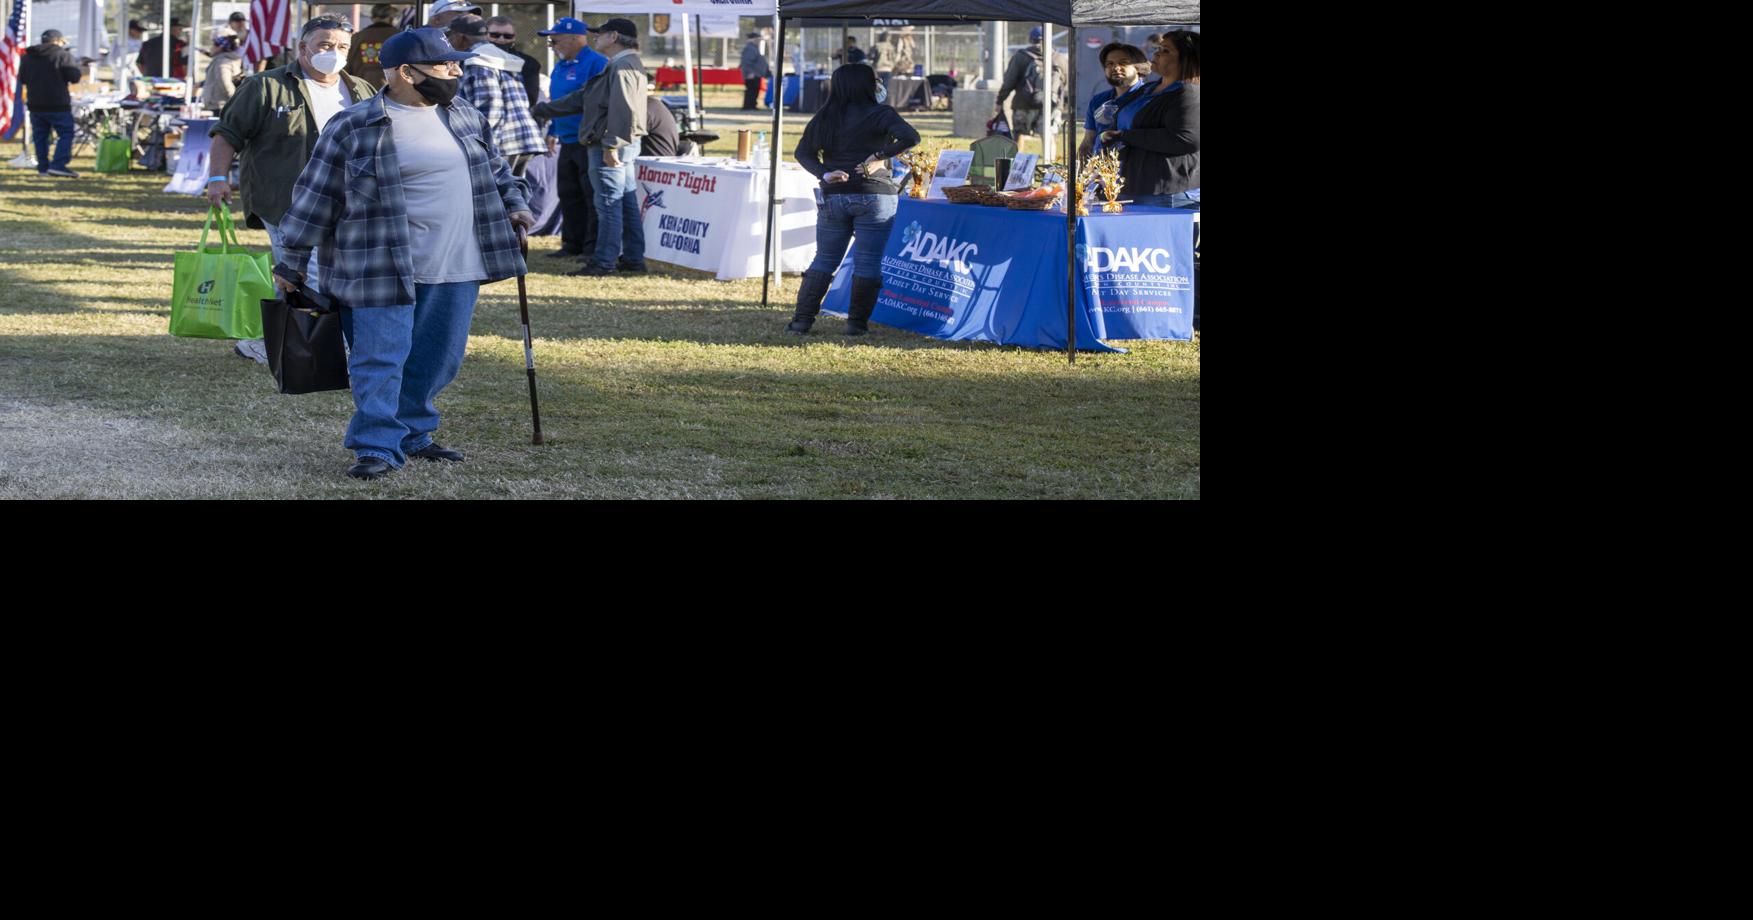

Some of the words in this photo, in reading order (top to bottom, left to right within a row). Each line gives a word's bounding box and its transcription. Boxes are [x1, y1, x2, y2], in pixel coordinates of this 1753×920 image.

[638, 165, 676, 185] Honor
[677, 171, 717, 194] Flight
[898, 230, 979, 275] ADAKC
